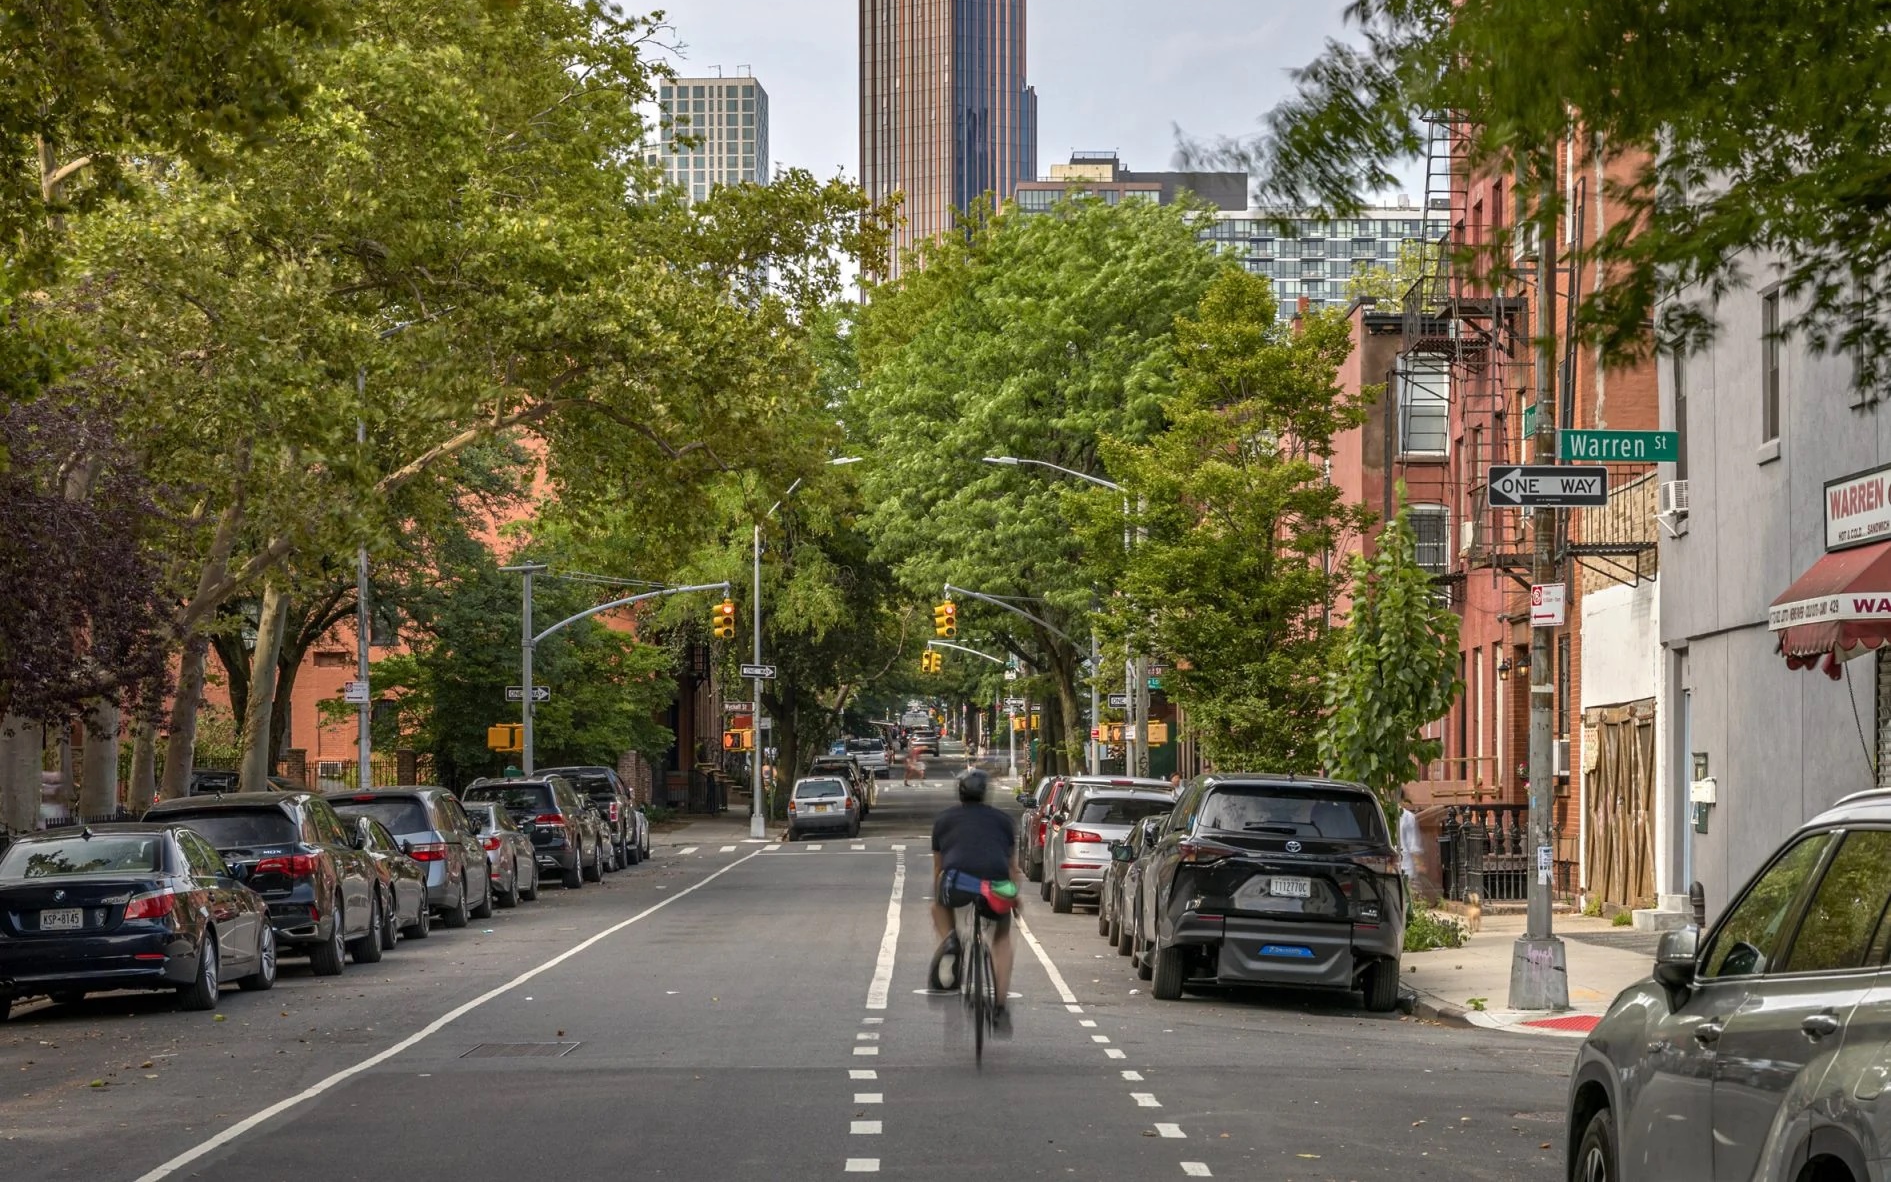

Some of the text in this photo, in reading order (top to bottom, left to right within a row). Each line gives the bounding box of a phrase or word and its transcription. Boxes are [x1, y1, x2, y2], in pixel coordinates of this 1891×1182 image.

[1570, 434, 1667, 457] Warren St
[1502, 478, 1597, 494] ONE WAY
[1829, 477, 1884, 521] WARREN
[1829, 599, 1839, 614] 429
[1274, 881, 1307, 893] T112770C
